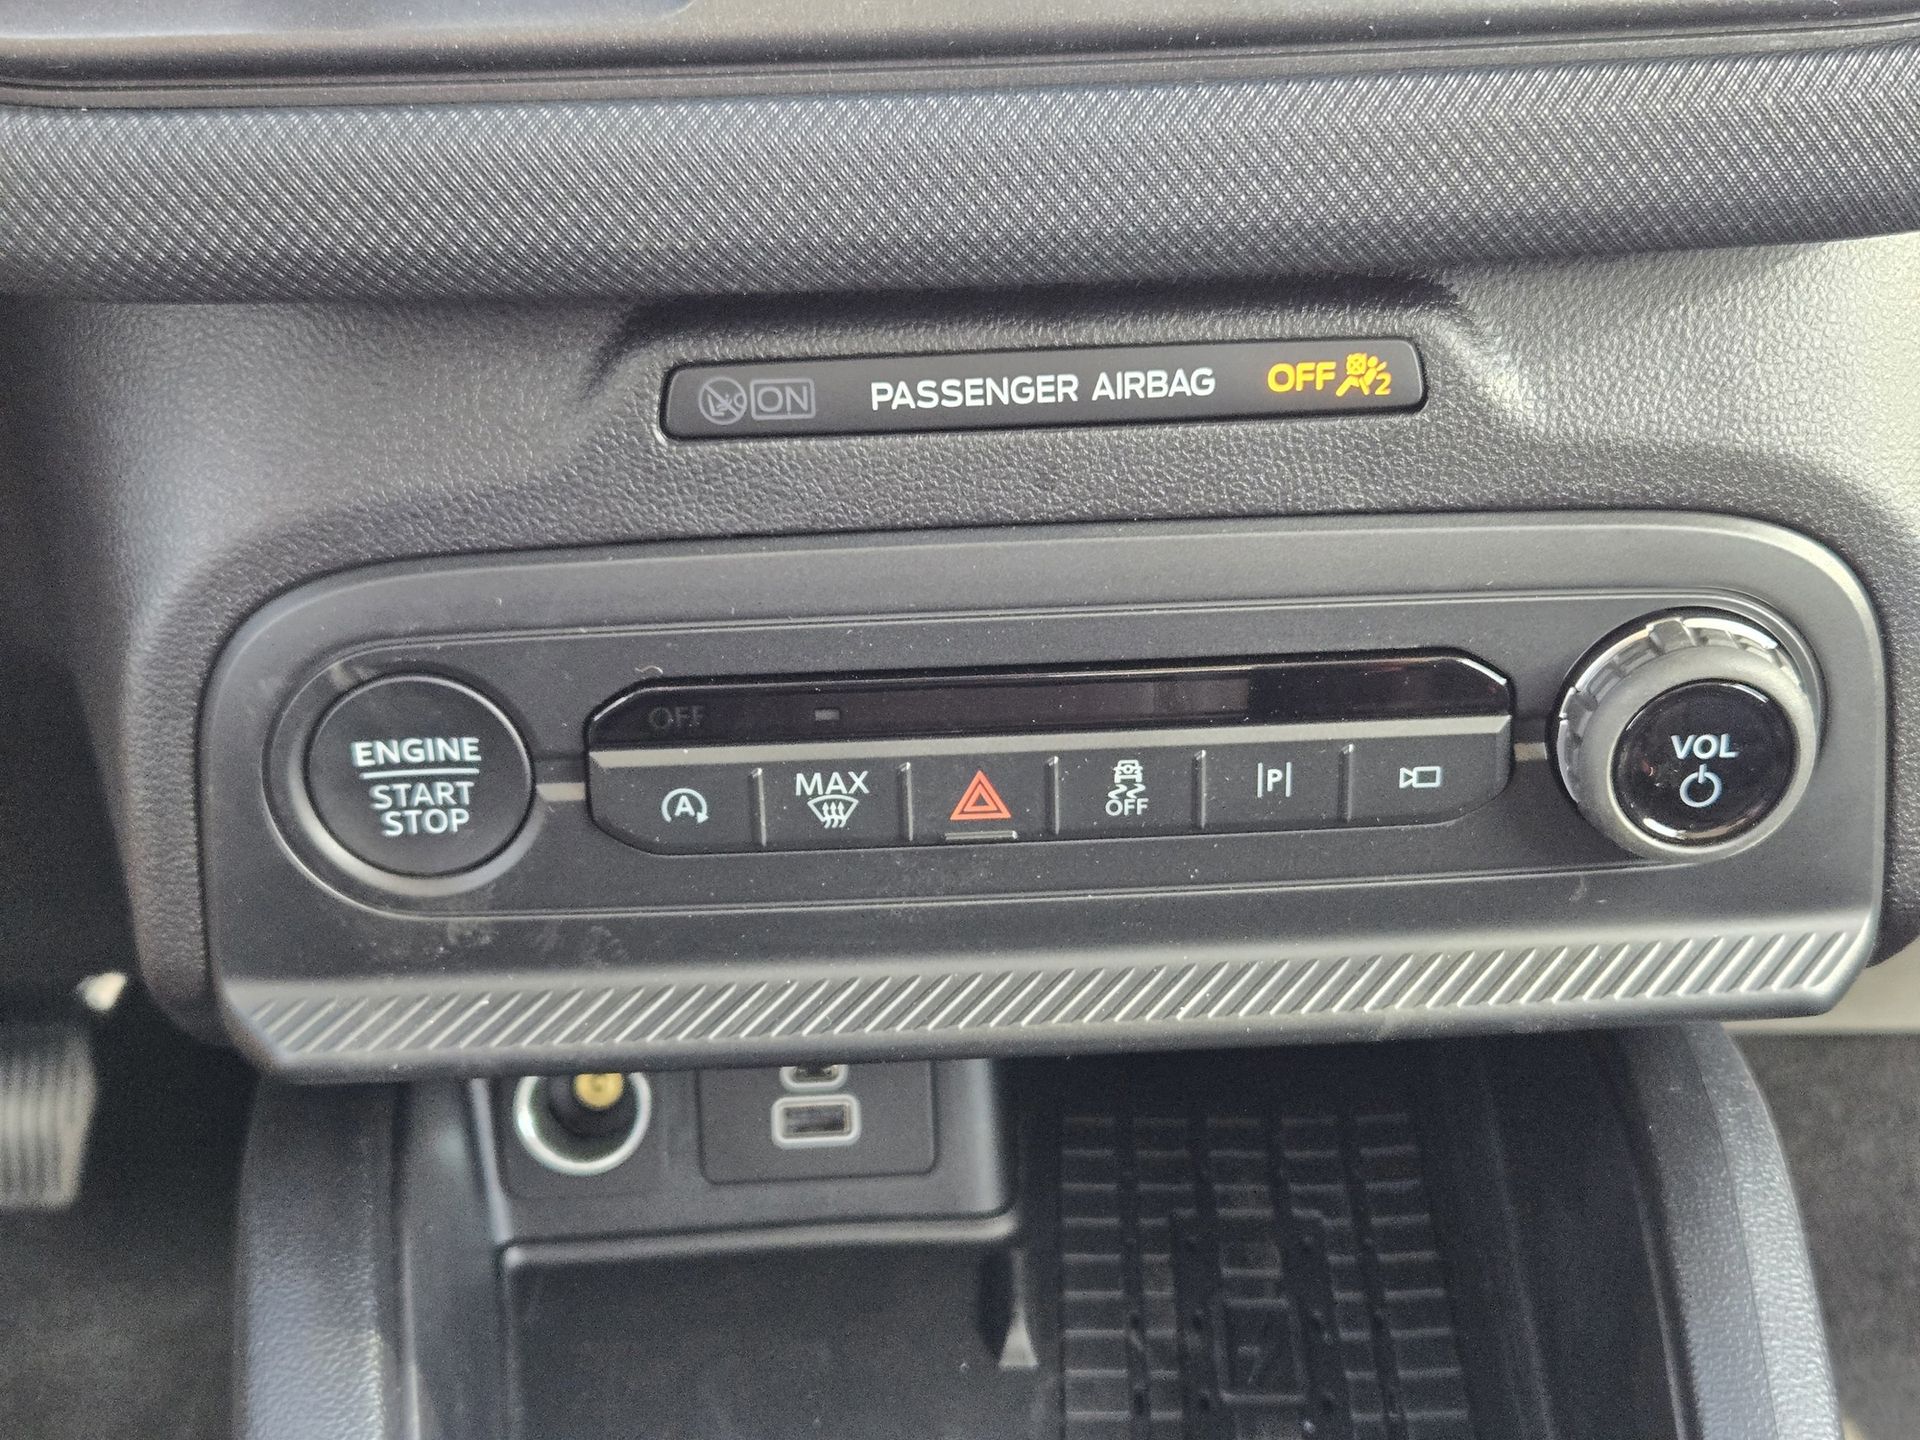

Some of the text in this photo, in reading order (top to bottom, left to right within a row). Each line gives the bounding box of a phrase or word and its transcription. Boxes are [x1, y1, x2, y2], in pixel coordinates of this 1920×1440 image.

[870, 367, 1216, 411] PASSENGER AIRBAG
[1266, 361, 1335, 394] OFF
[756, 383, 808, 416] ON
[649, 706, 703, 731] OFF
[353, 736, 482, 767] ENGINE
[1671, 734, 1740, 760] VOL
[371, 781, 474, 811] START
[795, 771, 870, 796] MAX
[1105, 797, 1149, 817] OFF
[382, 809, 470, 838] STOP
